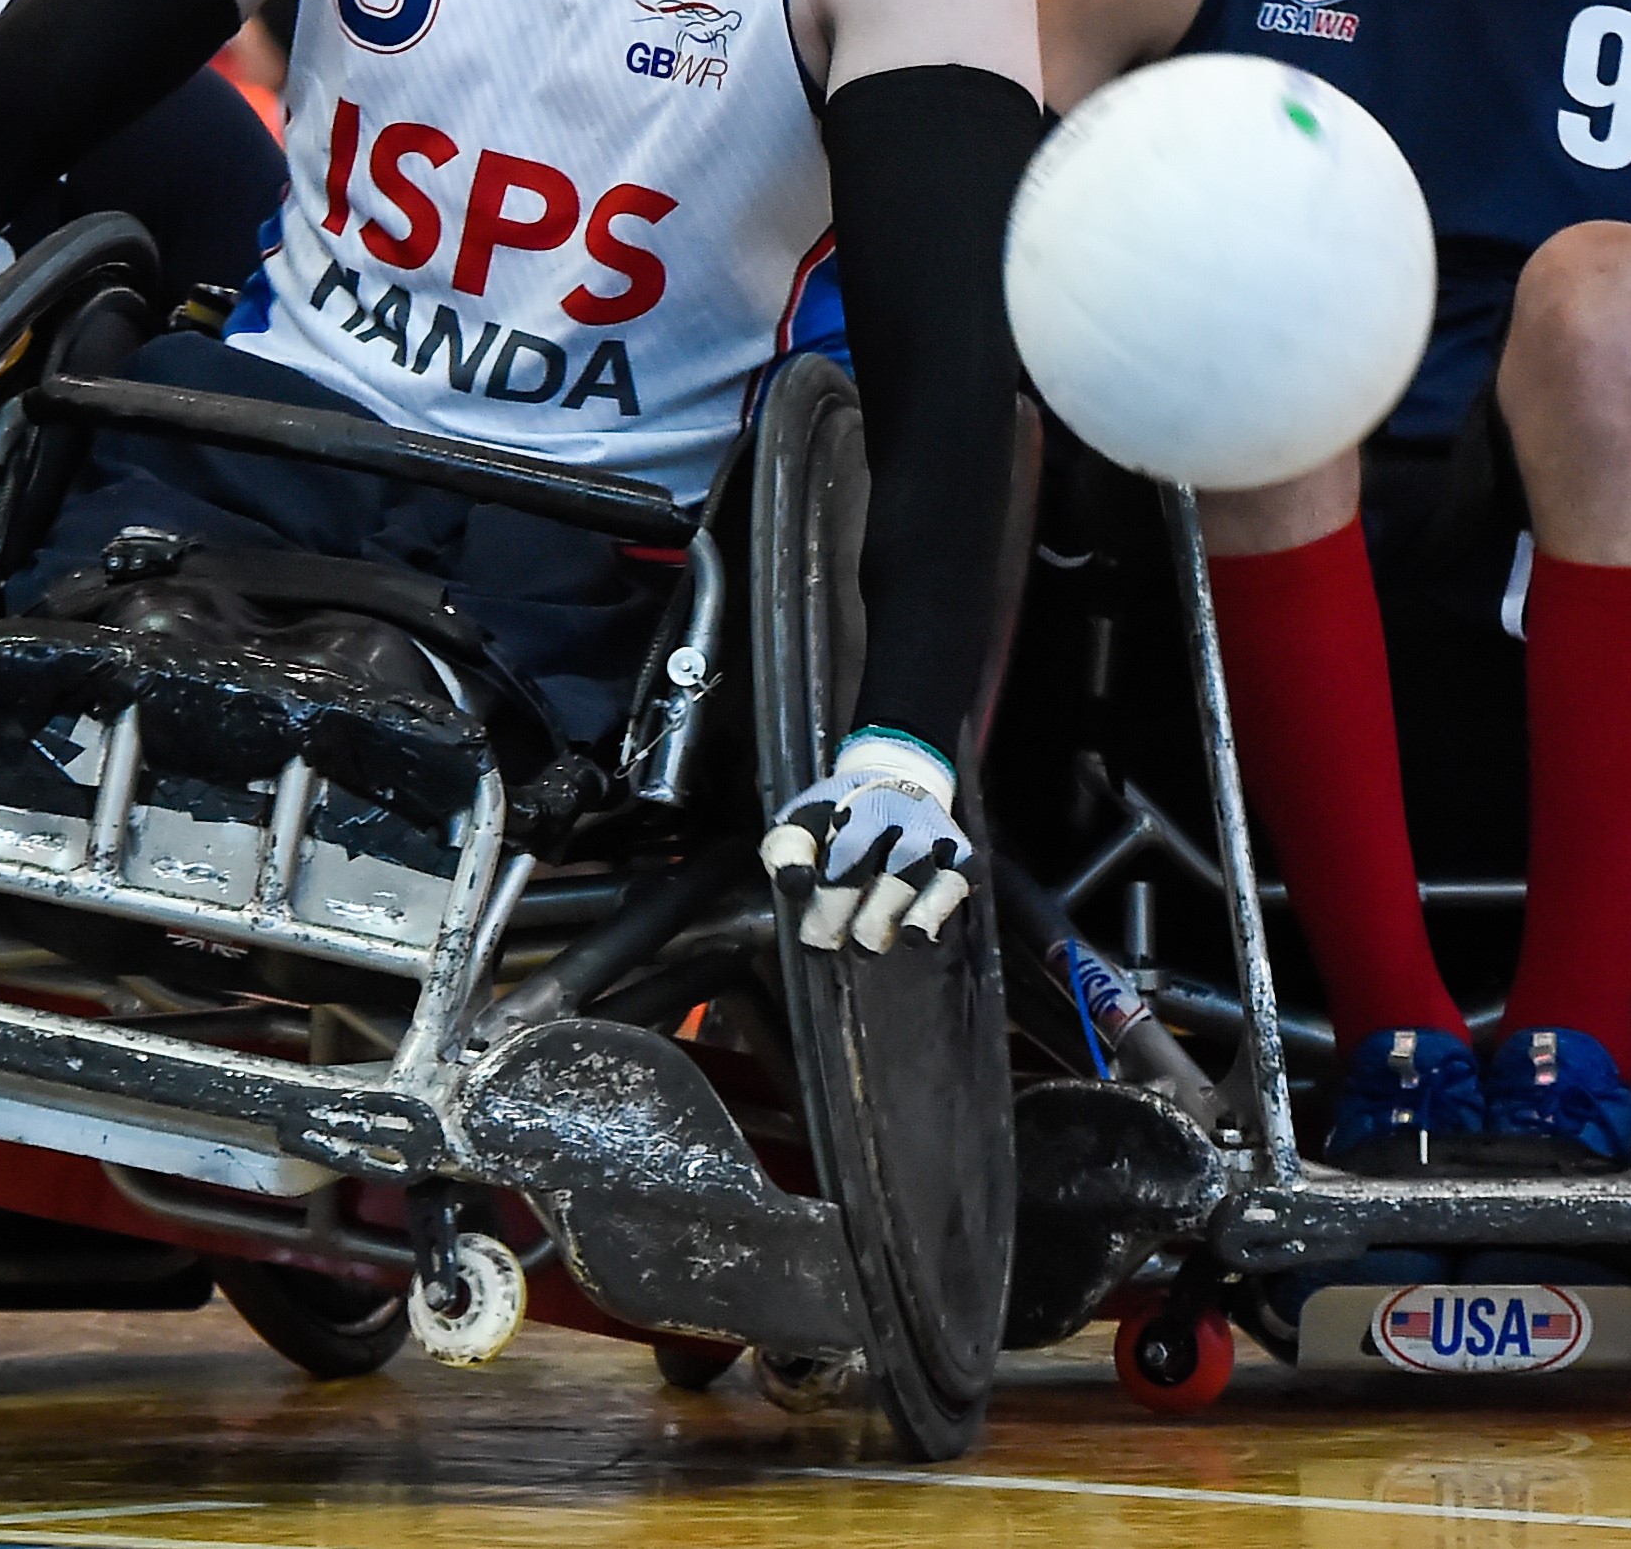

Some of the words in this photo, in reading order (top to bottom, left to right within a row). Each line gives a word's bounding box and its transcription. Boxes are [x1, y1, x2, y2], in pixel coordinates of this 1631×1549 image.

[1257, 2, 1360, 42] USAWR
[626, 42, 729, 91] GBWR
[321, 97, 680, 325] ISPS
[310, 259, 641, 416] HANDA
[1432, 1298, 1532, 1356] USA
